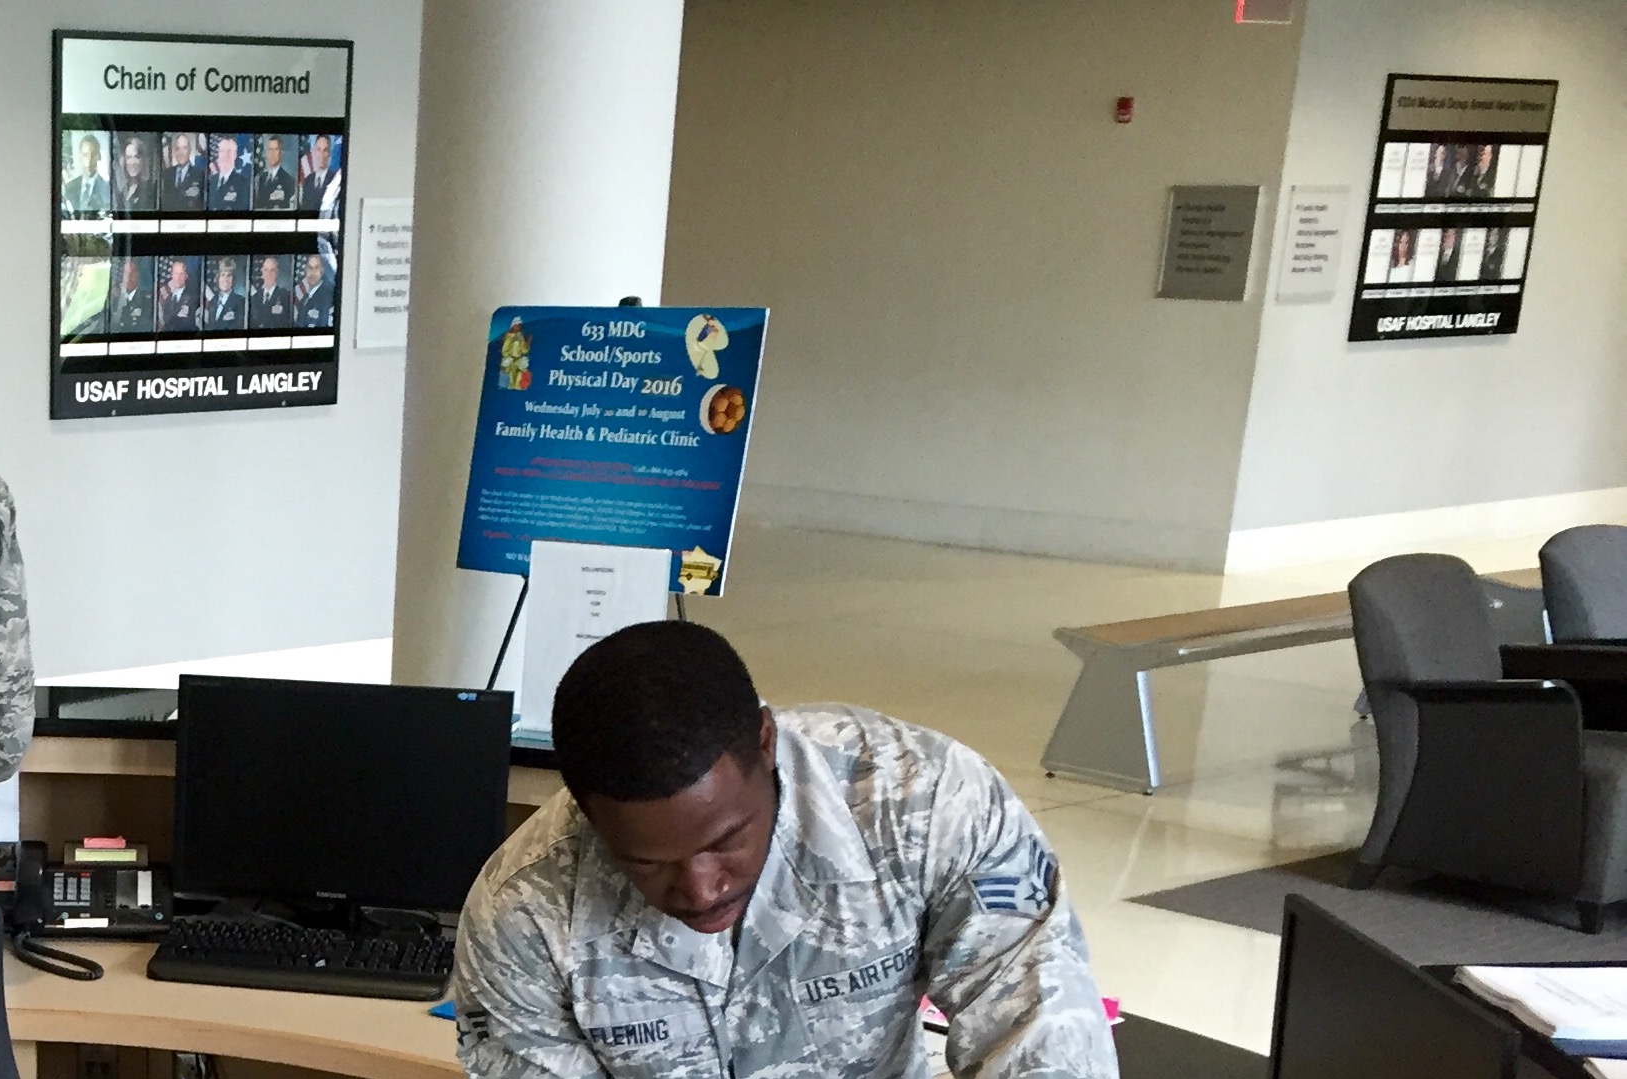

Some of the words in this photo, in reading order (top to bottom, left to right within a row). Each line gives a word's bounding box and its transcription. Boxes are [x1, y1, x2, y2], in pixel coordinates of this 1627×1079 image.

[104, 64, 166, 90] Chain
[175, 67, 197, 91] of
[204, 67, 311, 94] Command
[581, 321, 604, 342] 633
[607, 321, 646, 339] MDG
[1377, 316, 1407, 333] USAF
[1405, 314, 1454, 331] HOSPITAL
[1455, 312, 1502, 329] LANGLEY
[560, 345, 662, 367] School/Sports
[75, 380, 130, 403] USAF
[136, 376, 229, 400] HOSPITAL
[236, 371, 323, 395] LANGLEY
[548, 369, 609, 390] Physical
[610, 371, 639, 392] Day
[641, 375, 683, 396] 2016
[525, 400, 580, 418] Wednesday
[581, 403, 601, 419] July
[615, 405, 637, 418] and
[648, 407, 686, 422] August
[495, 421, 538, 442] Family
[539, 423, 583, 441] Health
[585, 426, 596, 441] &
[599, 426, 658, 446] Pediatric
[660, 429, 700, 447] Clinic
[805, 980, 845, 1003] U.S.
[848, 966, 881, 994] AIR
[881, 945, 919, 983] FOR
[588, 1019, 669, 1046] FLEMING
